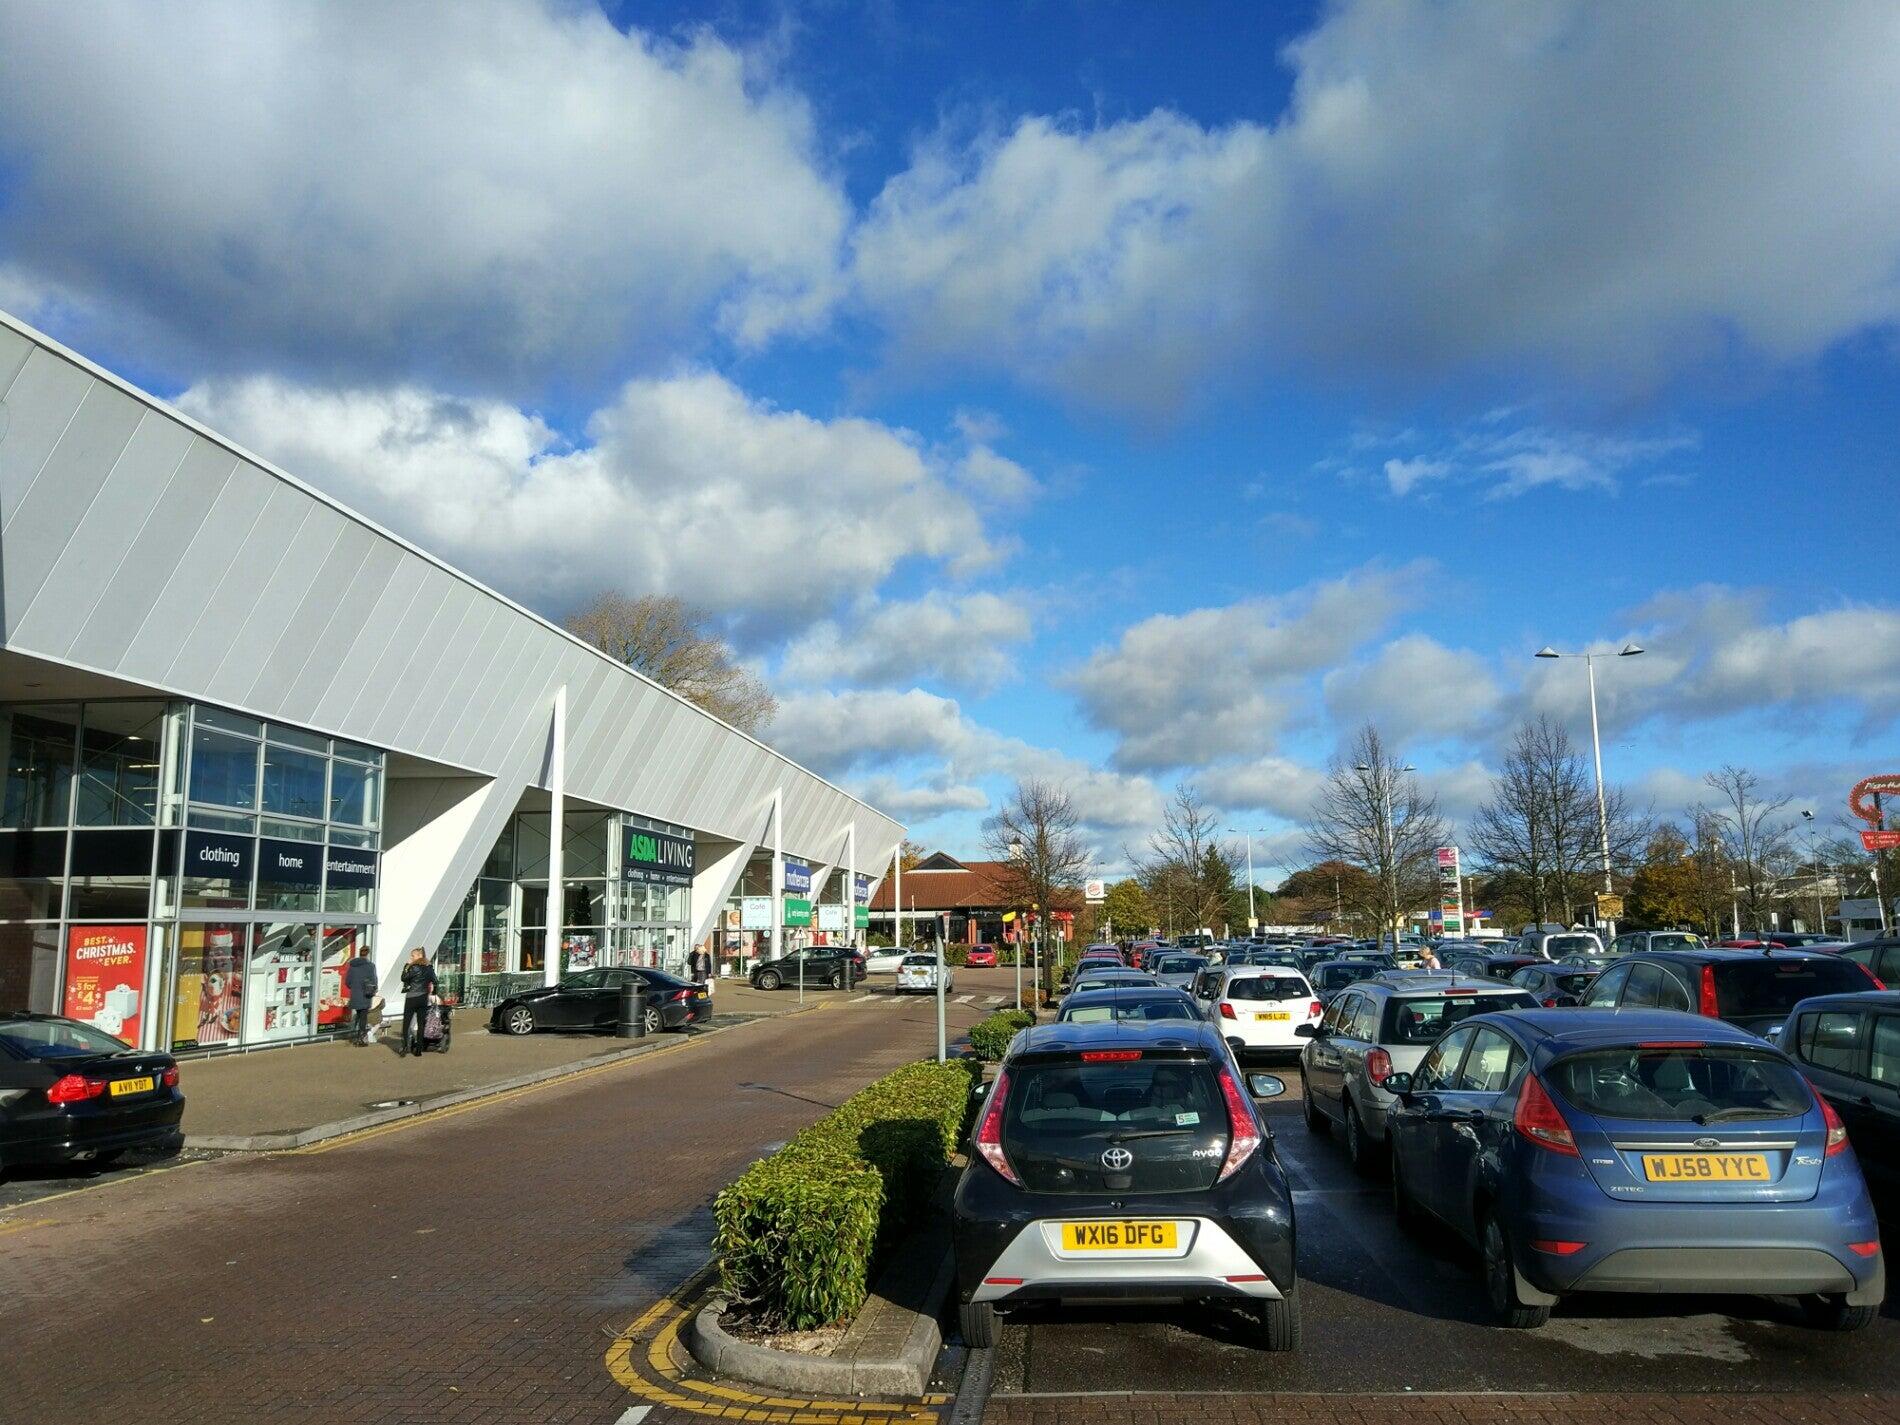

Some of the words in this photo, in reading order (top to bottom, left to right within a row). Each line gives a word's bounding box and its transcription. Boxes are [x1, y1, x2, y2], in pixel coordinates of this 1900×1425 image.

[199, 846, 240, 867] clothing
[629, 833, 656, 863] ASDA
[657, 839, 693, 868] LIVING
[278, 853, 303, 869] home
[326, 860, 376, 875] entertainment
[627, 868, 644, 881] clothing
[83, 936, 108, 947] BEST.
[75, 942, 137, 961] CHRISTMAS.
[103, 955, 132, 967] EVER.
[83, 982, 97, 991] for
[1651, 1157, 1712, 1178] WJ58
[1715, 1157, 1762, 1177] YYC
[1074, 1225, 1119, 1245] WX16
[1124, 1224, 1164, 1245] DFG
